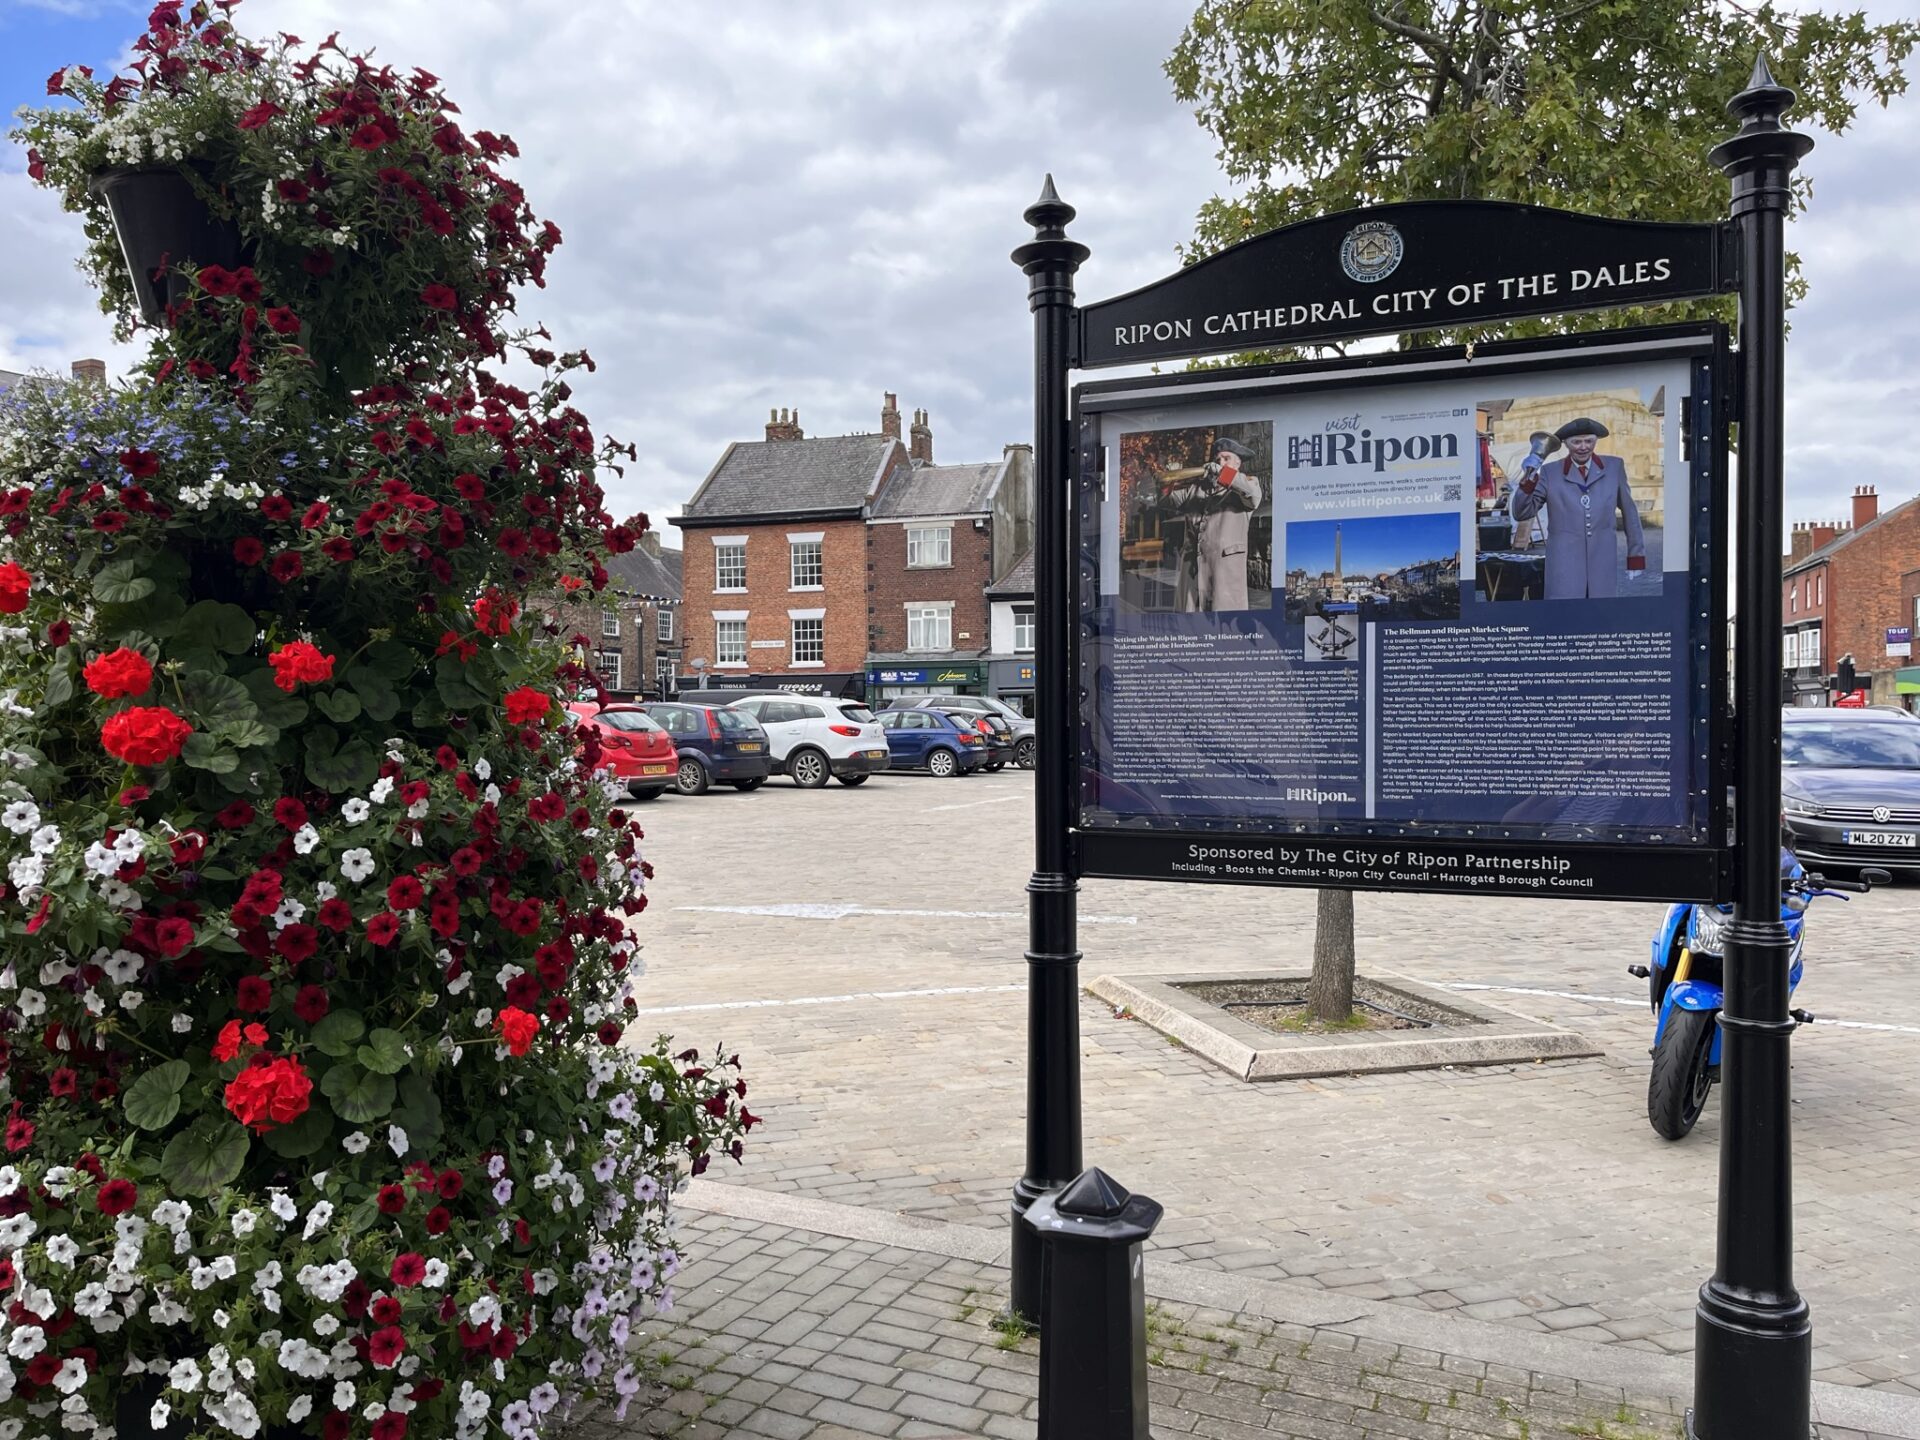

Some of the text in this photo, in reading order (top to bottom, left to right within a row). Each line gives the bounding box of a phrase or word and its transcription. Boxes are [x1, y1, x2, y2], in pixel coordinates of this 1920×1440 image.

[1116, 258, 1671, 346] RIPON CATHEDRAL CITY OF THE DALES
[1326, 413, 1361, 432] visit
[1326, 429, 1458, 472] Ripon
[1304, 492, 1442, 511] www.visitripon.co.uk
[1301, 788, 1347, 804] Ripon
[1854, 834, 1910, 844] ML20 ZZY
[1189, 844, 1570, 874] Sponsored by The City of Ripon Partnership
[1172, 862, 1215, 874] Including
[1226, 865, 1254, 874] Boots
[1257, 866, 1274, 874] the
[1278, 867, 1319, 877] Chemist
[1329, 869, 1358, 879] Ripon
[1363, 870, 1384, 880] City
[1389, 871, 1429, 881] Council
[1440, 873, 1495, 885] Harrogate
[1500, 875, 1546, 887] Borough
[1550, 877, 1593, 887] Council
